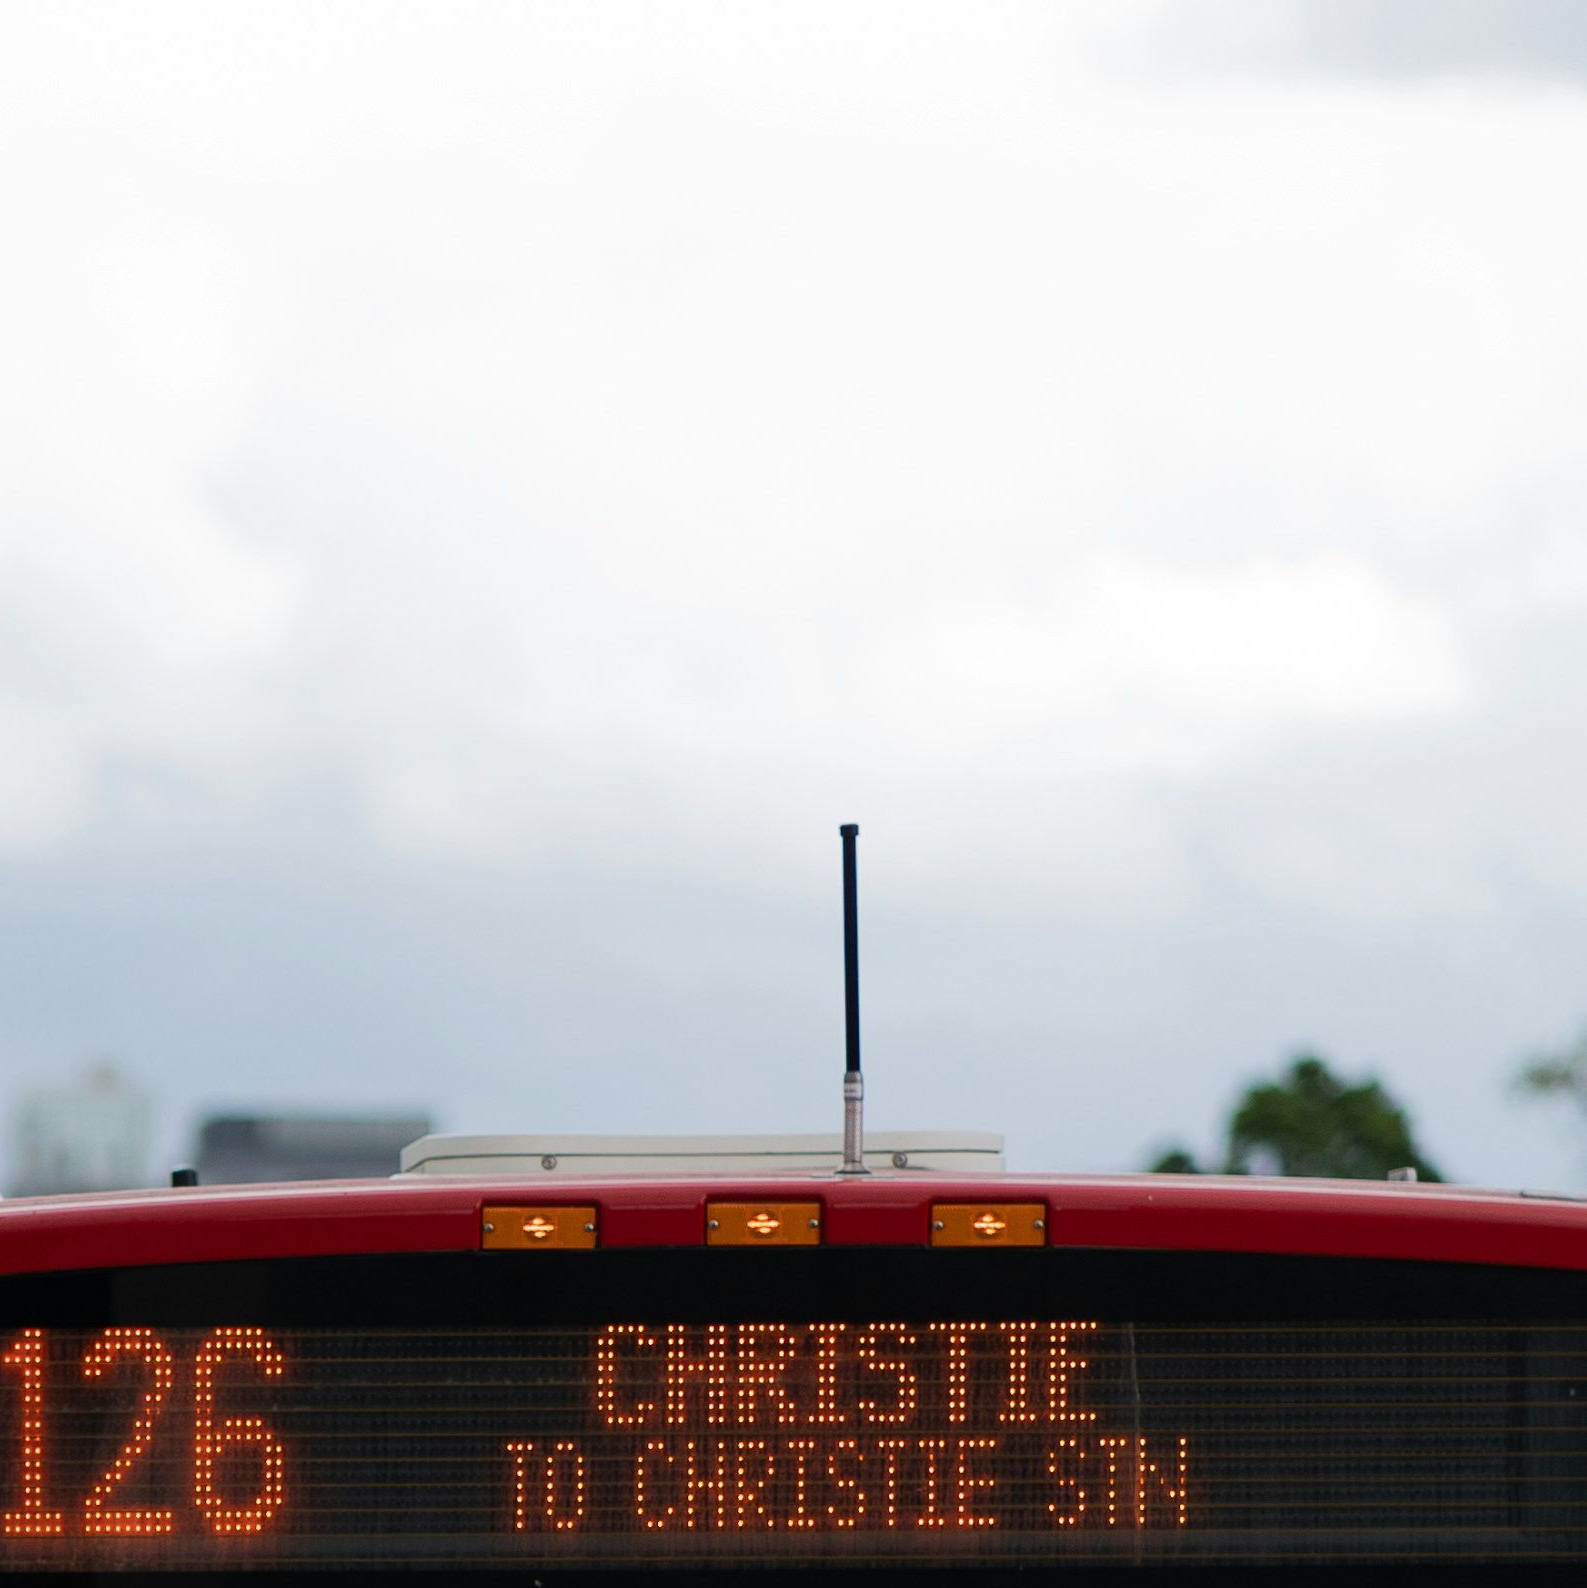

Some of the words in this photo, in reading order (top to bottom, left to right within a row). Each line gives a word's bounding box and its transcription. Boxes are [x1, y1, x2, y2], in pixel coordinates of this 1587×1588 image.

[596, 1321, 1099, 1424] CHRISTIE
[3, 1327, 283, 1535] 126
[505, 1441, 585, 1531] TO
[635, 1438, 997, 1530] CHRISTIE
[1047, 1436, 1189, 1527] STN
